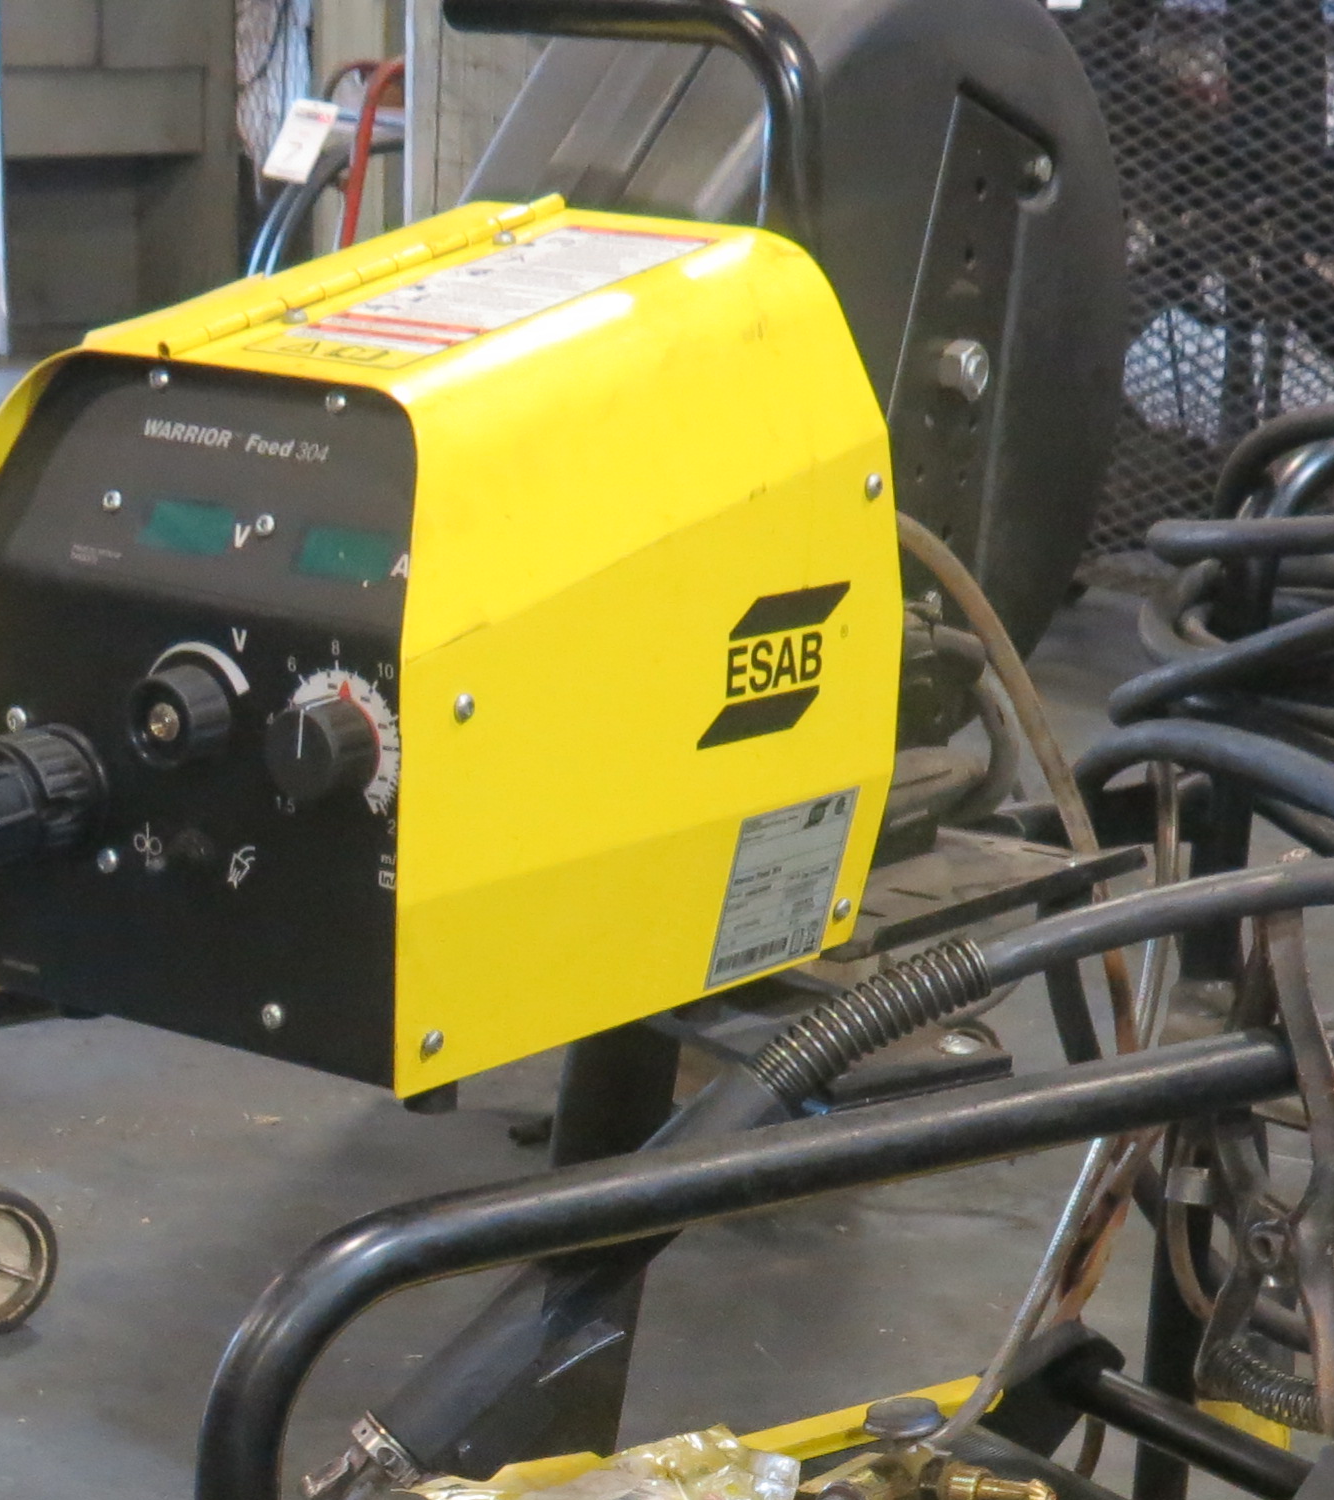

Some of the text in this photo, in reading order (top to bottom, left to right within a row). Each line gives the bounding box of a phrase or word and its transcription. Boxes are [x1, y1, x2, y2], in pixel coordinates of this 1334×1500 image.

[143, 418, 330, 463] WARRIOR Feed 304
[233, 522, 252, 549] V
[231, 627, 248, 653] V
[331, 639, 341, 656] 8
[286, 656, 298, 672] 6
[376, 662, 395, 680] 10
[726, 630, 823, 699] ESAB
